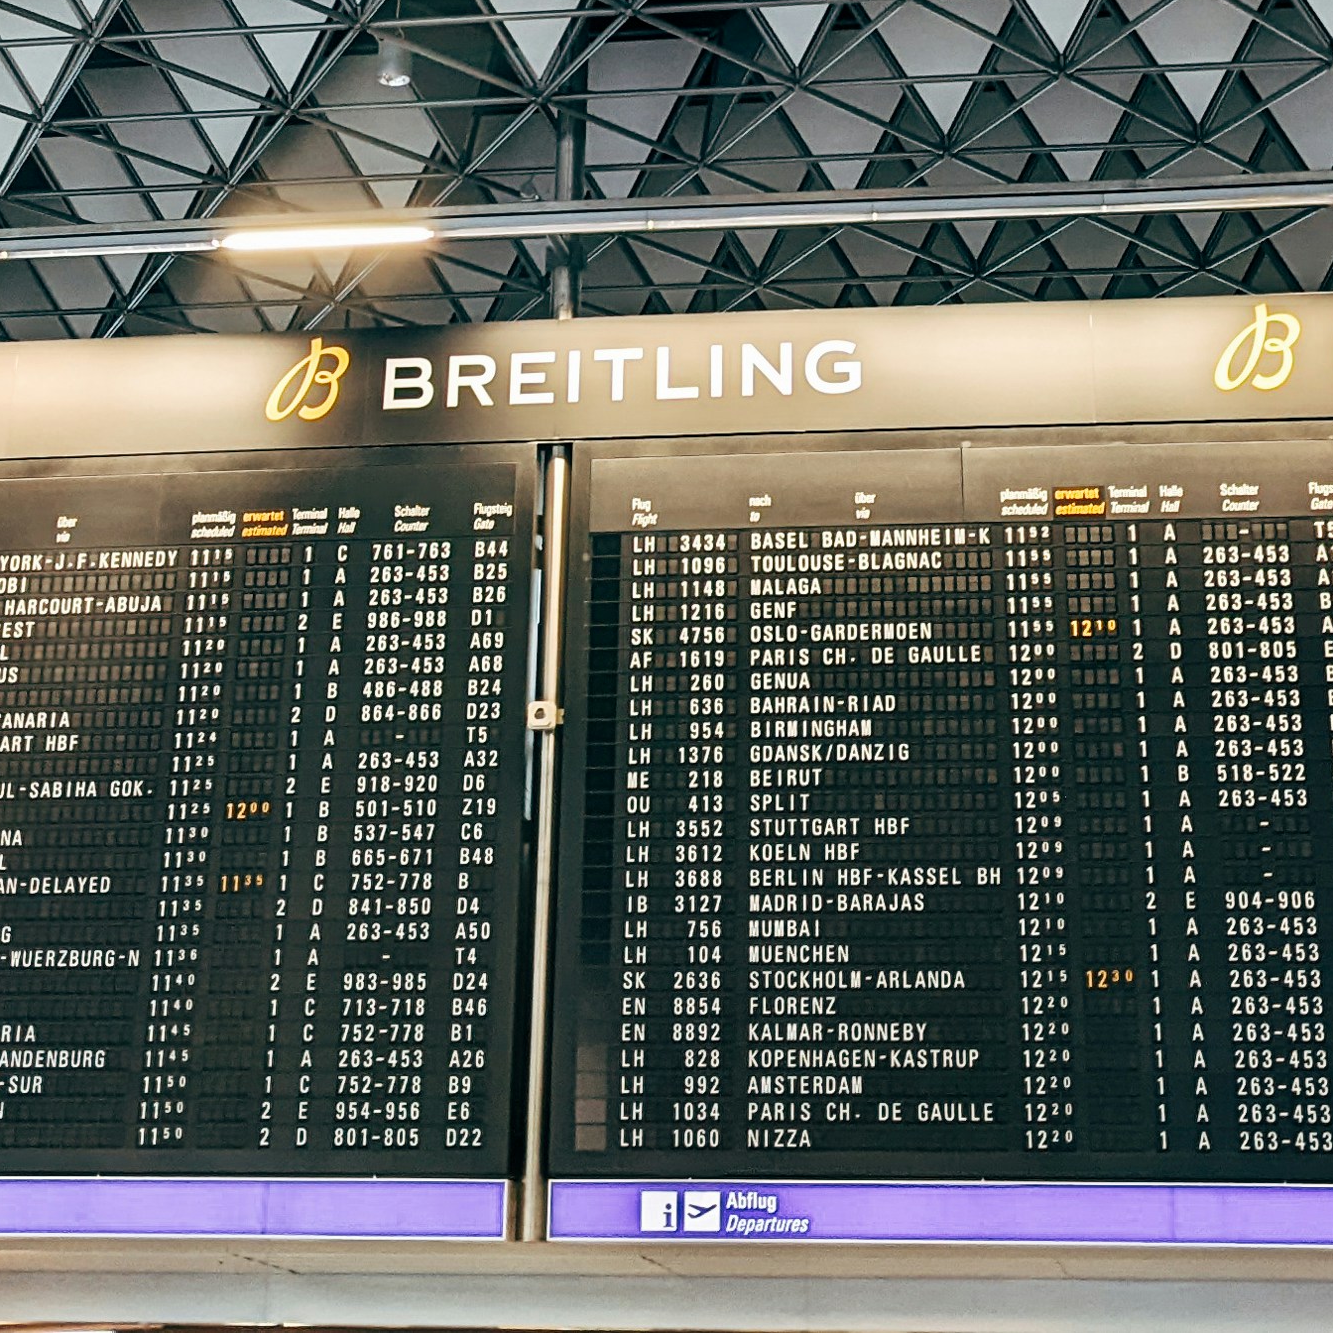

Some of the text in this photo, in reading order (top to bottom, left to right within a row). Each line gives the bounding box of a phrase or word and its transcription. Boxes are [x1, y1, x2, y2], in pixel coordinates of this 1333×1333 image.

[383, 340, 862, 410] BREITLING
[1055, 488, 1099, 499] erwartet
[1108, 485, 1147, 498] Terminal
[1159, 485, 1183, 497] Halle
[1220, 483, 1259, 496] Schalter
[474, 502, 512, 517] Flugsteig
[632, 498, 651, 512] Flug
[1001, 502, 1048, 516] scheduled
[1056, 502, 1105, 515] estimated
[1111, 501, 1150, 514] Terminal
[1161, 500, 1180, 513] Hall
[1222, 499, 1260, 512] Counter
[1310, 497, 1333, 510] Gate
[243, 511, 284, 523] erwartet
[292, 508, 327, 520] Terminal
[338, 507, 360, 519] Halle
[394, 505, 430, 517] Schalter
[750, 511, 760, 522] to
[394, 520, 429, 532] Counter
[474, 518, 495, 530] Gate
[632, 513, 658, 528] Flight
[191, 525, 235, 538] scheduled
[242, 524, 288, 537] estimated
[292, 522, 328, 535] Terminal
[337, 522, 356, 534] Hall
[750, 552, 942, 572] TOULOUSE-BLAGNAC
[474, 562, 508, 580] B25
[632, 582, 654, 599] LH
[680, 580, 725, 598] 1148
[750, 578, 822, 596] MALAGA
[1204, 568, 1291, 588] 263-453
[4, 595, 162, 616] HARCOURT-ABUJA
[367, 610, 446, 629] 986-988
[750, 622, 932, 643] OSLO-GARDERMOEN
[750, 694, 896, 714] BAHRAIN-RIAD
[750, 719, 872, 738] BIRMINGHAM
[45, 734, 78, 752] HBF
[750, 743, 910, 763] GDANSK/DANZIG
[352, 848, 432, 866] 665-671
[460, 847, 494, 865] B48
[750, 842, 860, 862] KOELN HBF
[628, 892, 924, 913] IB 3127 MADRID-BARAJAS
[750, 996, 836, 1015] FLORENZ
[748, 1048, 979, 1068] KOPENHAGEN-KASTRUP
[446, 1128, 482, 1146] D22
[620, 1128, 811, 1148] LH 1060 NIZZA
[726, 1191, 777, 1212] Abflug
[726, 1214, 809, 1234] Departures
